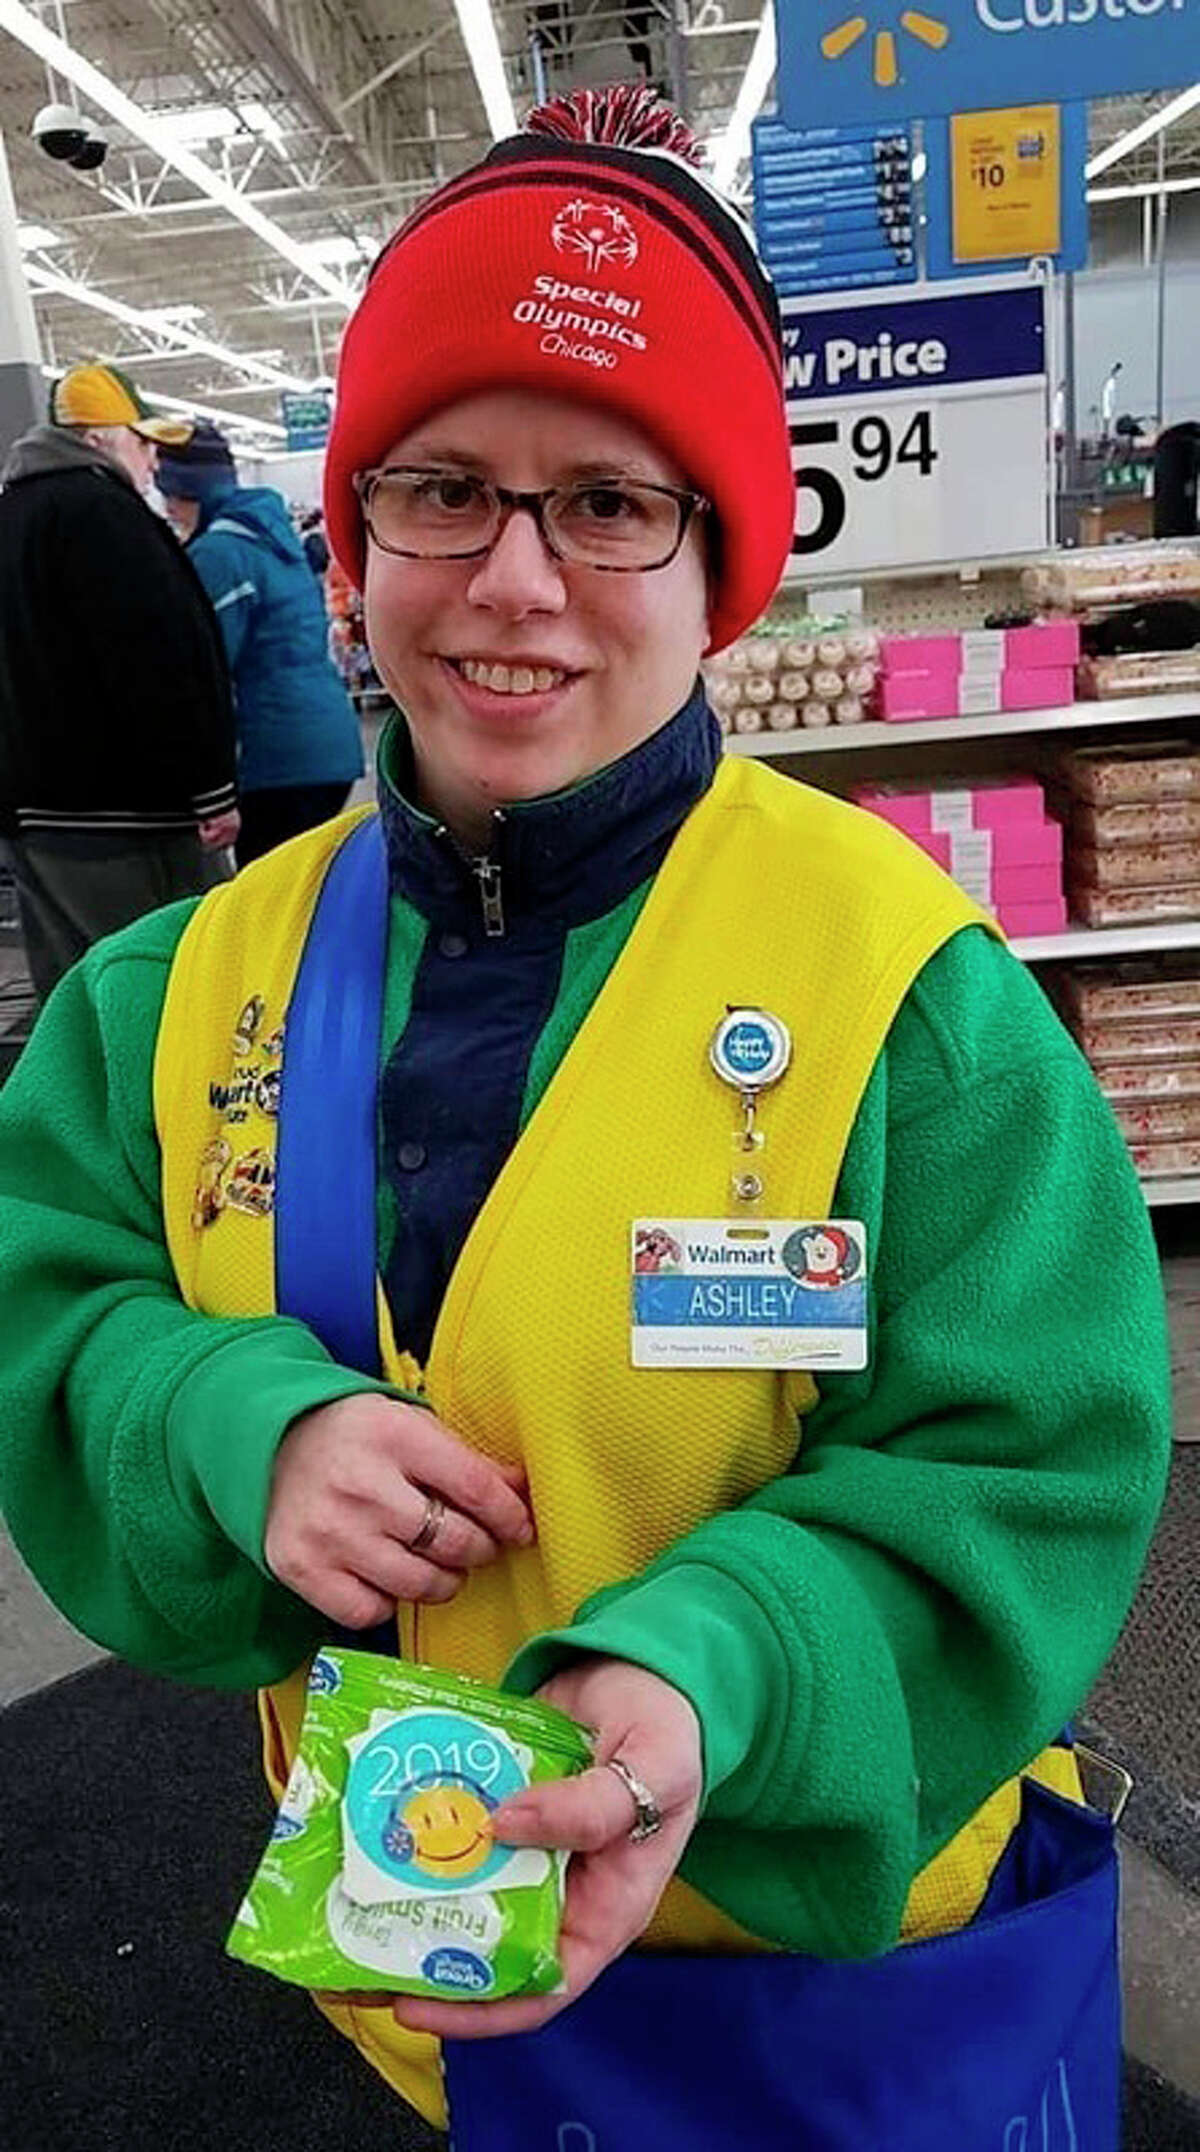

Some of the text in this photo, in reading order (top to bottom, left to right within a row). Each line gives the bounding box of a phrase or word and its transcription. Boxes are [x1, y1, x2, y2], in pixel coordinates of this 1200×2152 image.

[533, 275, 641, 318] Special
[513, 300, 647, 351] Olympics
[539, 333, 619, 369] Chicago
[825, 333, 947, 385] Price
[687, 1245, 776, 1265] Walmart
[689, 1284, 798, 1317] ASHLEY
[367, 1739, 501, 1797] 2019
[433, 1908, 488, 1938] Fruit
